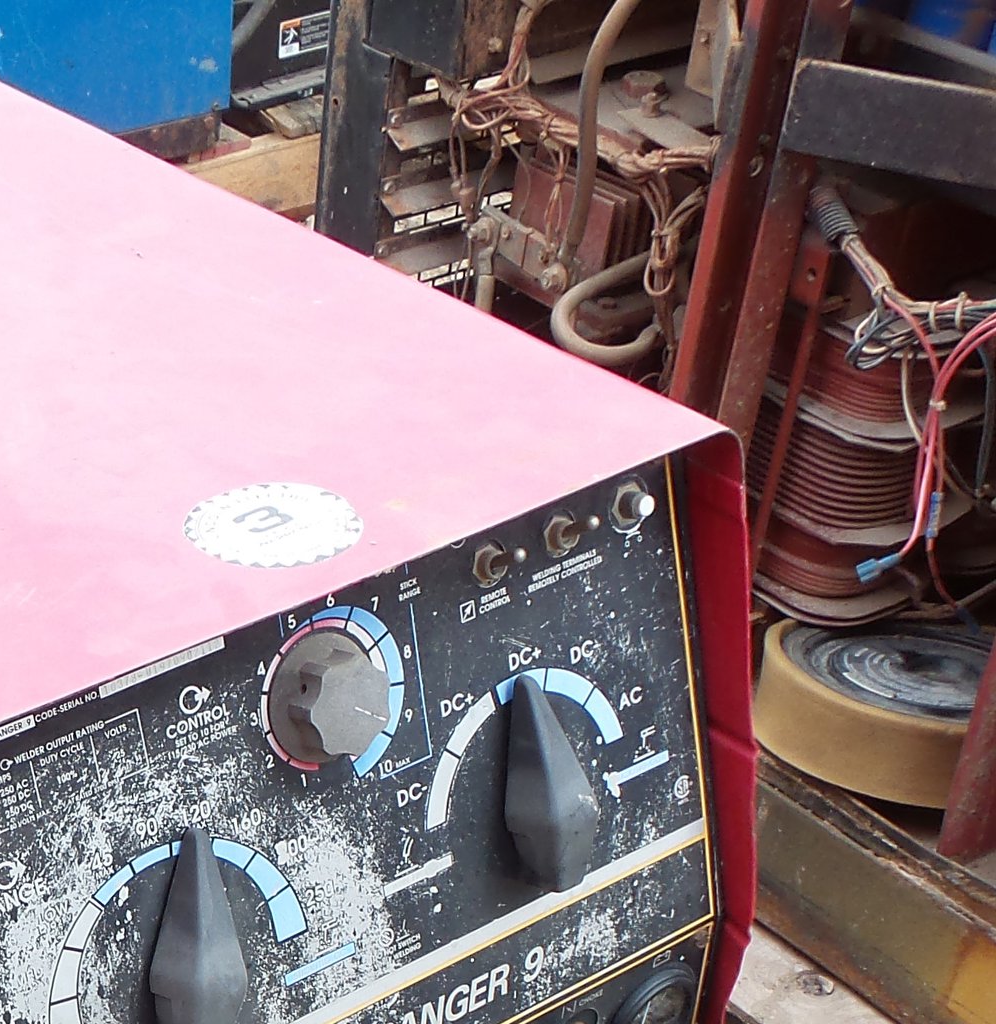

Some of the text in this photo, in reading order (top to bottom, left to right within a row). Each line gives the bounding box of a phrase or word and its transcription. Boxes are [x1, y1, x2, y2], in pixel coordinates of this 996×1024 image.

[531, 549, 597, 582] WELDING TERMINALS
[399, 577, 418, 591] STICK
[527, 556, 603, 594] REMOTELY CONTROLLED
[326, 593, 335, 608] 6
[398, 586, 422, 602] RANGE
[480, 586, 508, 604] REMOTE
[371, 596, 380, 612] 7
[479, 595, 511, 614] CONTROL
[287, 614, 297, 629] 5
[404, 644, 412, 659] 8
[508, 646, 542, 671] DC+
[257, 661, 266, 676] 4
[35, 697, 84, 722] CODE-SERIAL
[85, 690, 100, 703] NO.
[440, 691, 475, 718] DC+
[618, 686, 644, 711] AC
[166, 704, 230, 739] CONTROL
[250, 712, 258, 727] 3
[405, 709, 413, 723] 9
[105, 724, 127, 739] VOLTS
[175, 722, 225, 748] SET TO 10 FOR
[197, 736, 211, 748] AC
[211, 725, 238, 743] POWER
[14, 721, 105, 764] WELDER OUTPUT RATING
[40, 741, 85, 767] DUTY CYCLE
[266, 754, 275, 769] 2
[379, 757, 412, 776] 10 MAX
[57, 770, 78, 784] 100%
[300, 773, 307, 787] 1
[0, 779, 29, 797] 250 AC
[18, 788, 31, 801] DC
[396, 782, 428, 809] DC-
[5, 800, 33, 818] 250 DC
[183, 801, 211, 826] 120
[136, 818, 158, 841] 90
[231, 808, 261, 836] 160
[141, 837, 159, 849] MAX
[91, 853, 113, 871] 45
[38, 900, 69, 925] LOW
[398, 932, 421, 950] SWITCH
[523, 946, 545, 982] 9
[578, 989, 604, 1007] CHOKE
